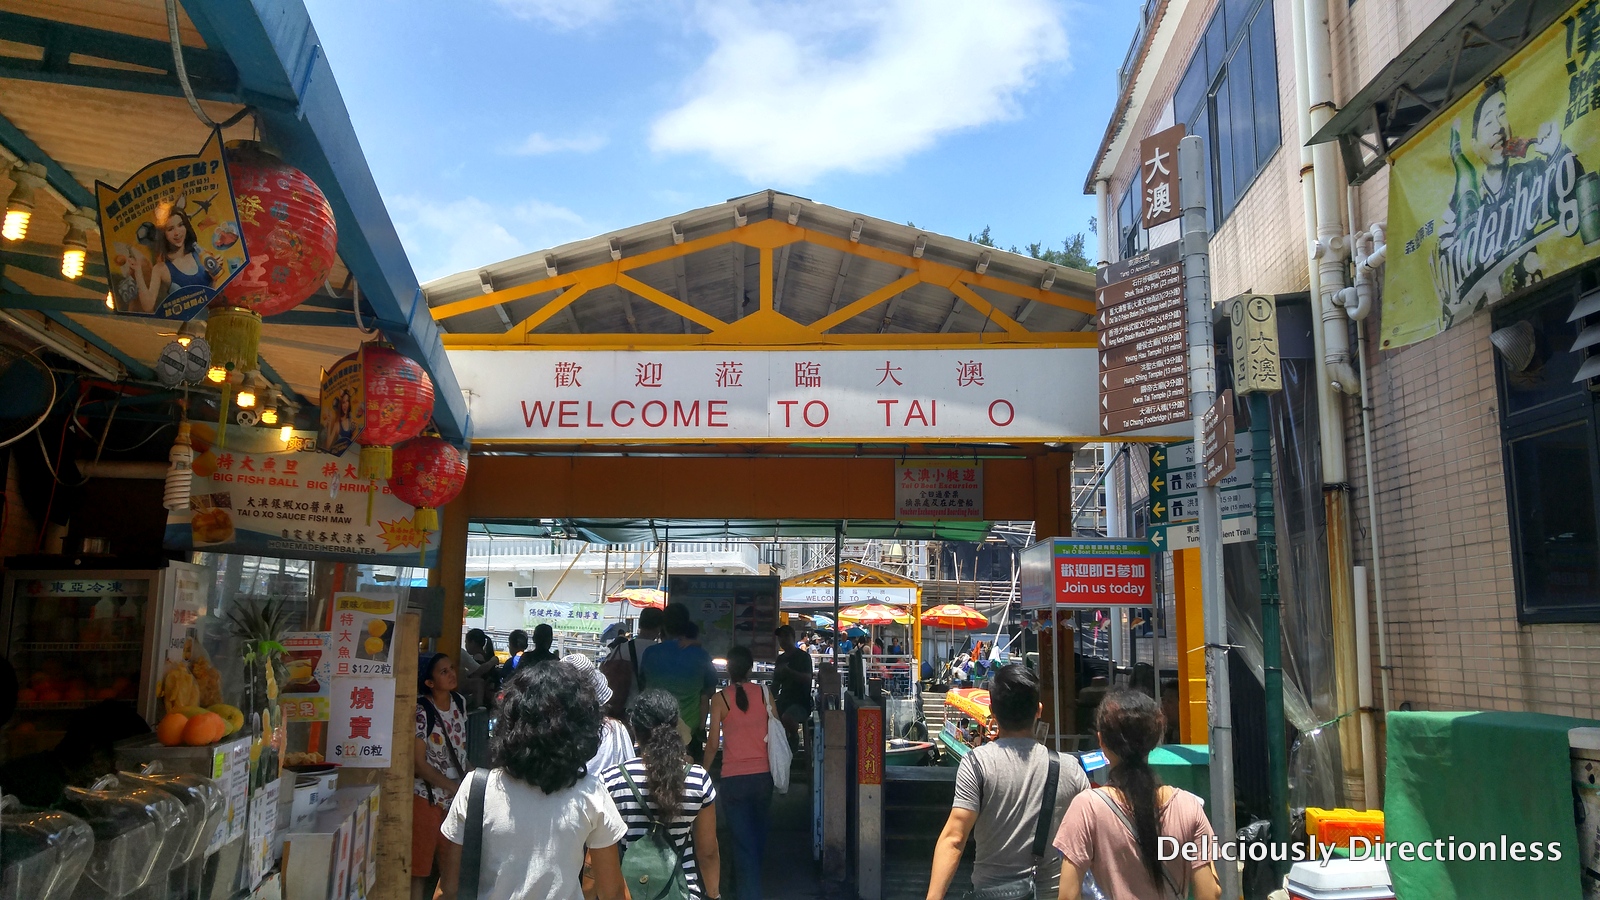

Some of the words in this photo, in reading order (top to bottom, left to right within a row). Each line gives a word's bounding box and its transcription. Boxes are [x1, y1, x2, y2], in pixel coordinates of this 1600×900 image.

[1145, 147, 1172, 220] 大澳
[1146, 348, 1163, 357] Temple
[1169, 342, 1183, 351] mins)
[1235, 336, 1244, 350] O
[1250, 331, 1278, 383] 大澳
[553, 360, 985, 388] 歡迎蒞臨大澳
[1147, 370, 1164, 379] Temple
[1170, 365, 1184, 373] mins)
[1237, 357, 1247, 386] Tai
[1150, 391, 1167, 401] Temple
[1171, 387, 1185, 396] mins)
[521, 399, 729, 428] WELCOME
[776, 399, 830, 428] TO
[877, 399, 937, 428] TAI
[988, 399, 1016, 428] O
[1129, 417, 1144, 427] Chung
[1143, 413, 1168, 424] Footbridge
[1172, 410, 1186, 418] mins)
[217, 453, 299, 476] 特大魚旦
[213, 473, 234, 483] BIG
[236, 475, 265, 485] FISH
[268, 477, 300, 489] BALL
[306, 480, 328, 491] BIG
[903, 467, 976, 482] 大澳小艇遊
[1220, 475, 1238, 484] mple
[237, 508, 251, 517] TAI
[252, 510, 260, 518] O
[262, 510, 275, 519] XO
[276, 511, 306, 521] SAUCE
[308, 514, 329, 523] FISH
[330, 515, 353, 525] MAW
[1187, 509, 1199, 517] Hung
[1230, 504, 1238, 512] (15
[1238, 502, 1253, 510] mins)
[1236, 528, 1251, 536] Trail
[269, 540, 320, 551] HOMEMADE
[322, 544, 358, 554] HERBAL
[359, 546, 377, 556] TEA
[1061, 563, 1145, 578] 歡迎即日參加
[51, 581, 124, 593] 東亞冷凍
[1062, 581, 1089, 593] Join
[1092, 584, 1106, 594] us
[1109, 581, 1145, 597] today
[336, 612, 354, 675] 特大魚旦
[352, 664, 392, 675] $12/2粒
[348, 686, 374, 740] 燒賣
[864, 718, 876, 774] 大吉大利
